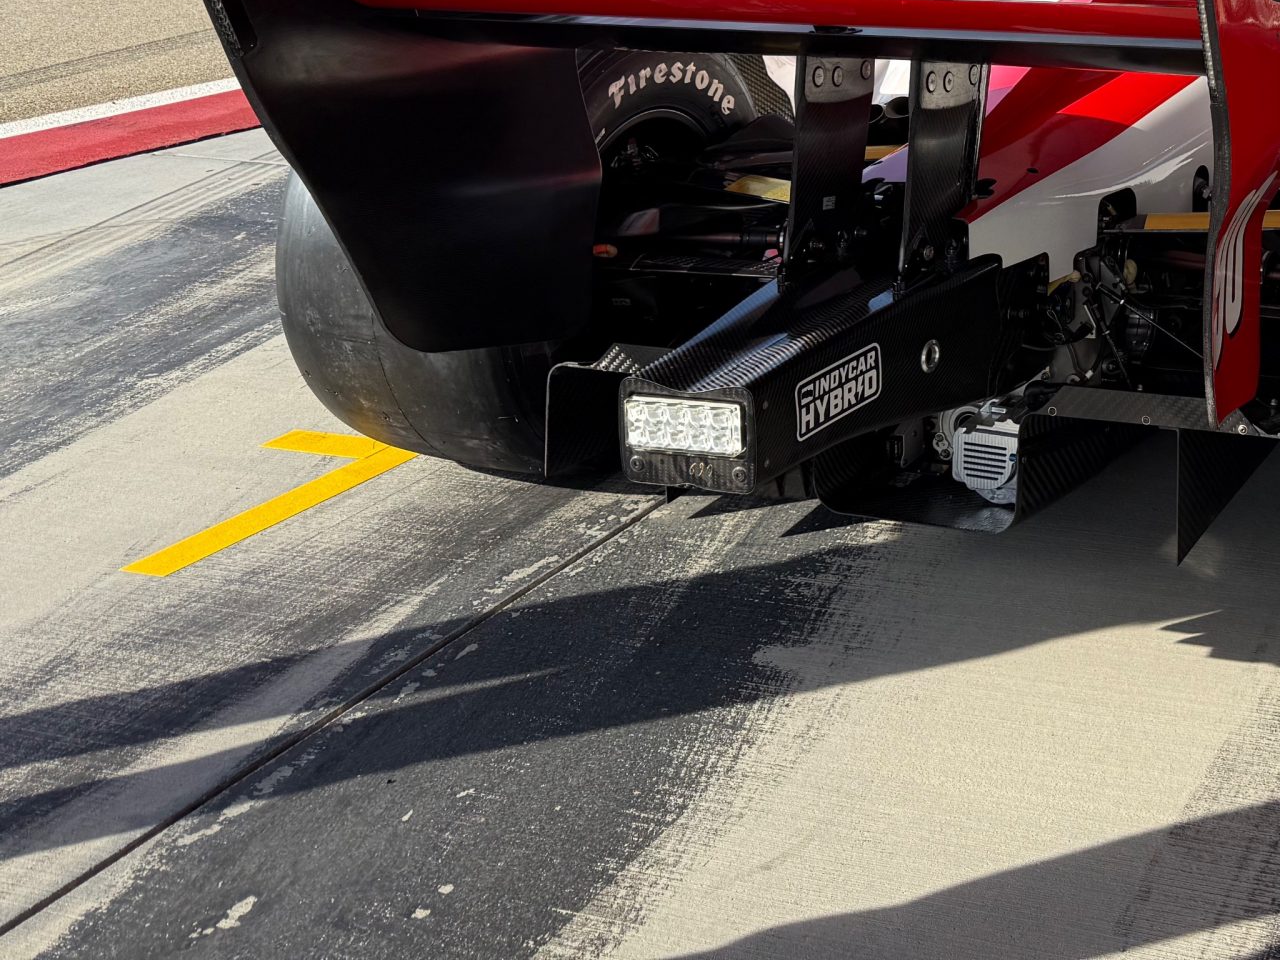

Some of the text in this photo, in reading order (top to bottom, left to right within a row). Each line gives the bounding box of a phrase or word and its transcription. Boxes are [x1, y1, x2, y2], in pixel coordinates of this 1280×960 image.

[608, 61, 735, 116] Firestone
[801, 369, 878, 434] HYBRID
[815, 350, 876, 398] INDYCAR
